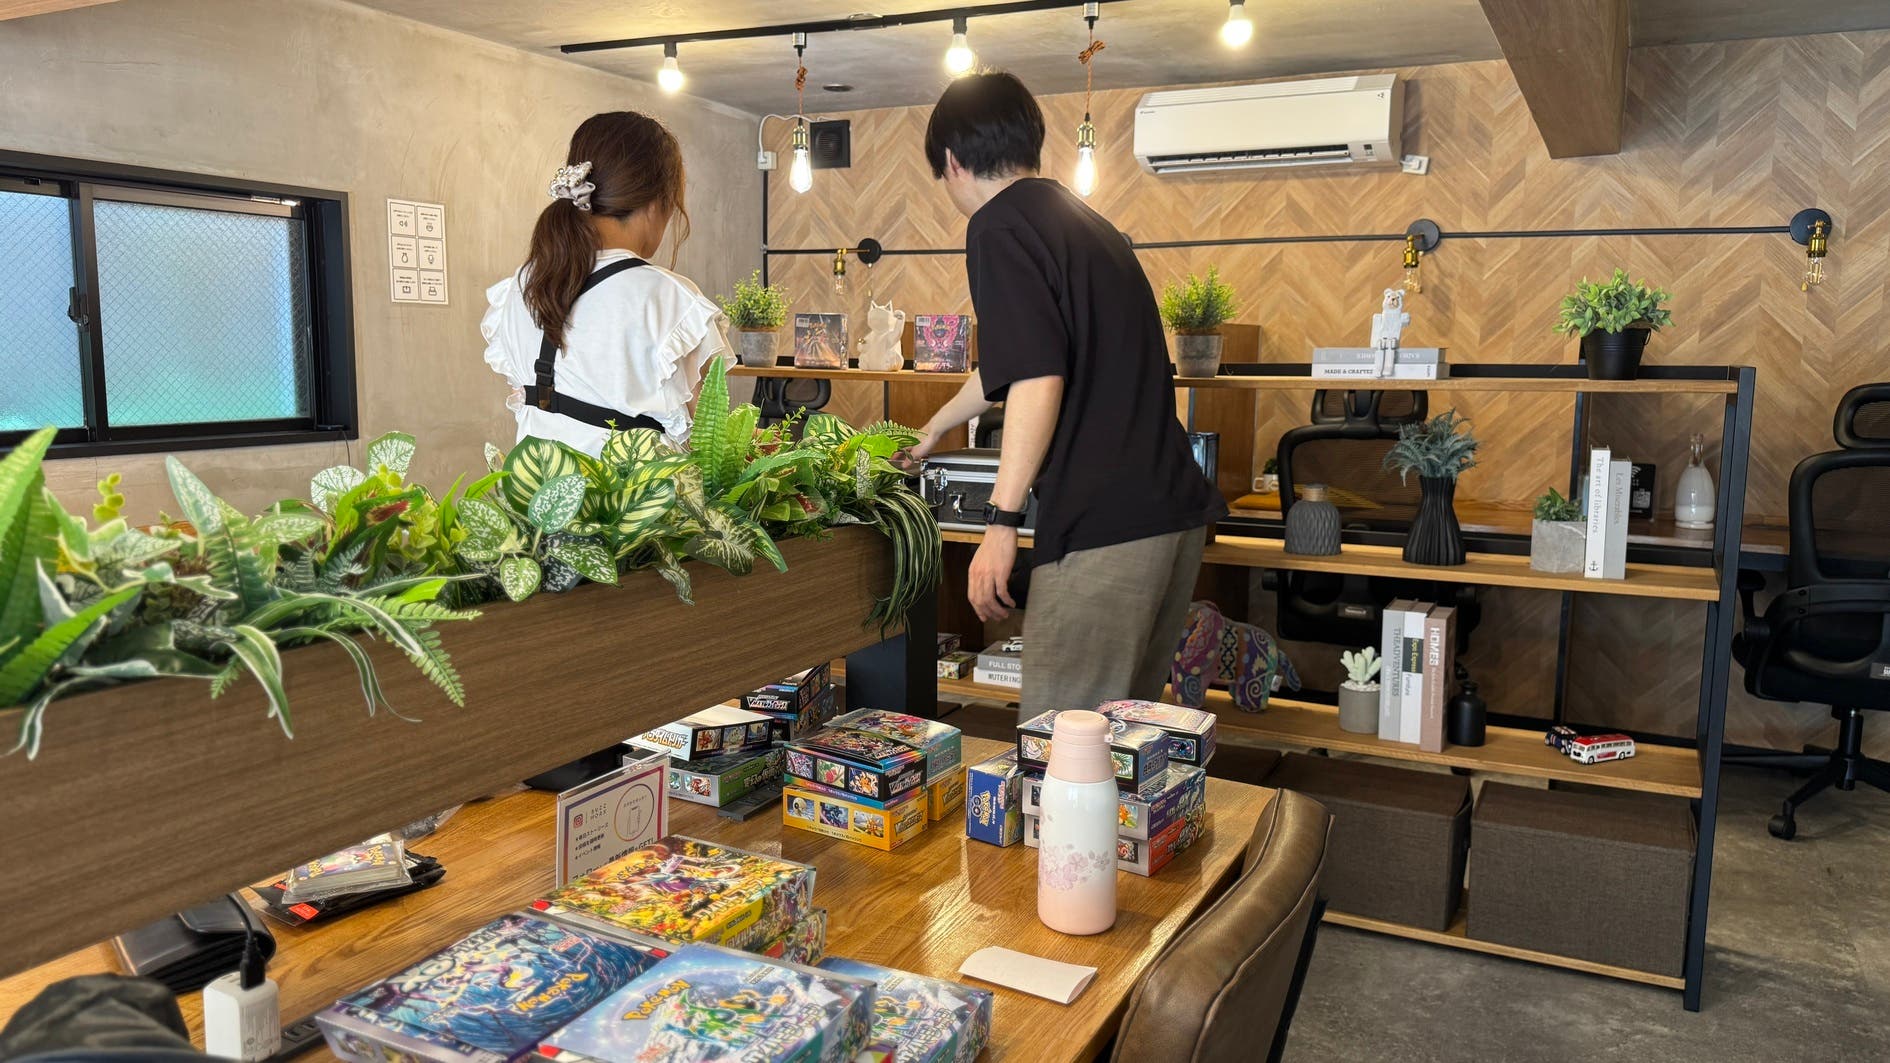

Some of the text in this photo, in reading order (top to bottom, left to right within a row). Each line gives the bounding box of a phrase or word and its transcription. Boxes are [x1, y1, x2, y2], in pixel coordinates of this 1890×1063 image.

[1615, 472, 1624, 486] Les
[1591, 456, 1605, 534] The art of libraries
[1428, 626, 1441, 666] HOMES
[988, 660, 1006, 670] FULL
